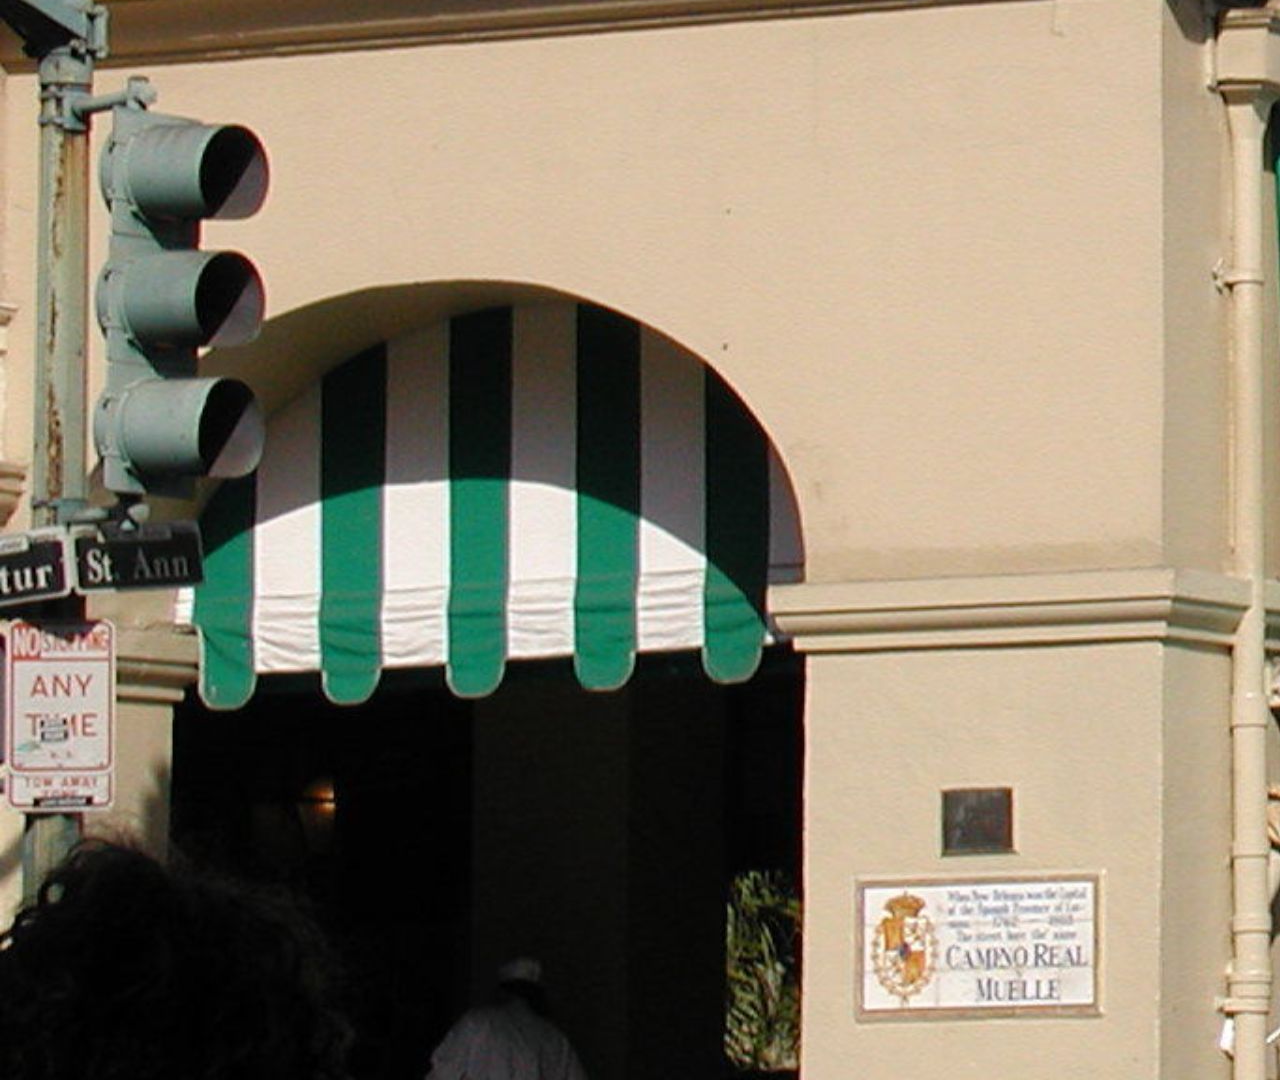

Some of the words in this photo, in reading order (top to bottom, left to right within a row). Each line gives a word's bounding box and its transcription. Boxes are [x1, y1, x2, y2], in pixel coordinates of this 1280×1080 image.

[133, 546, 190, 580] Ann
[30, 674, 93, 698] ANY
[25, 712, 98, 737] TE
[945, 945, 1029, 970] CAMINO
[1034, 943, 1088, 967] REAL
[976, 977, 1060, 1001] MUELLE
